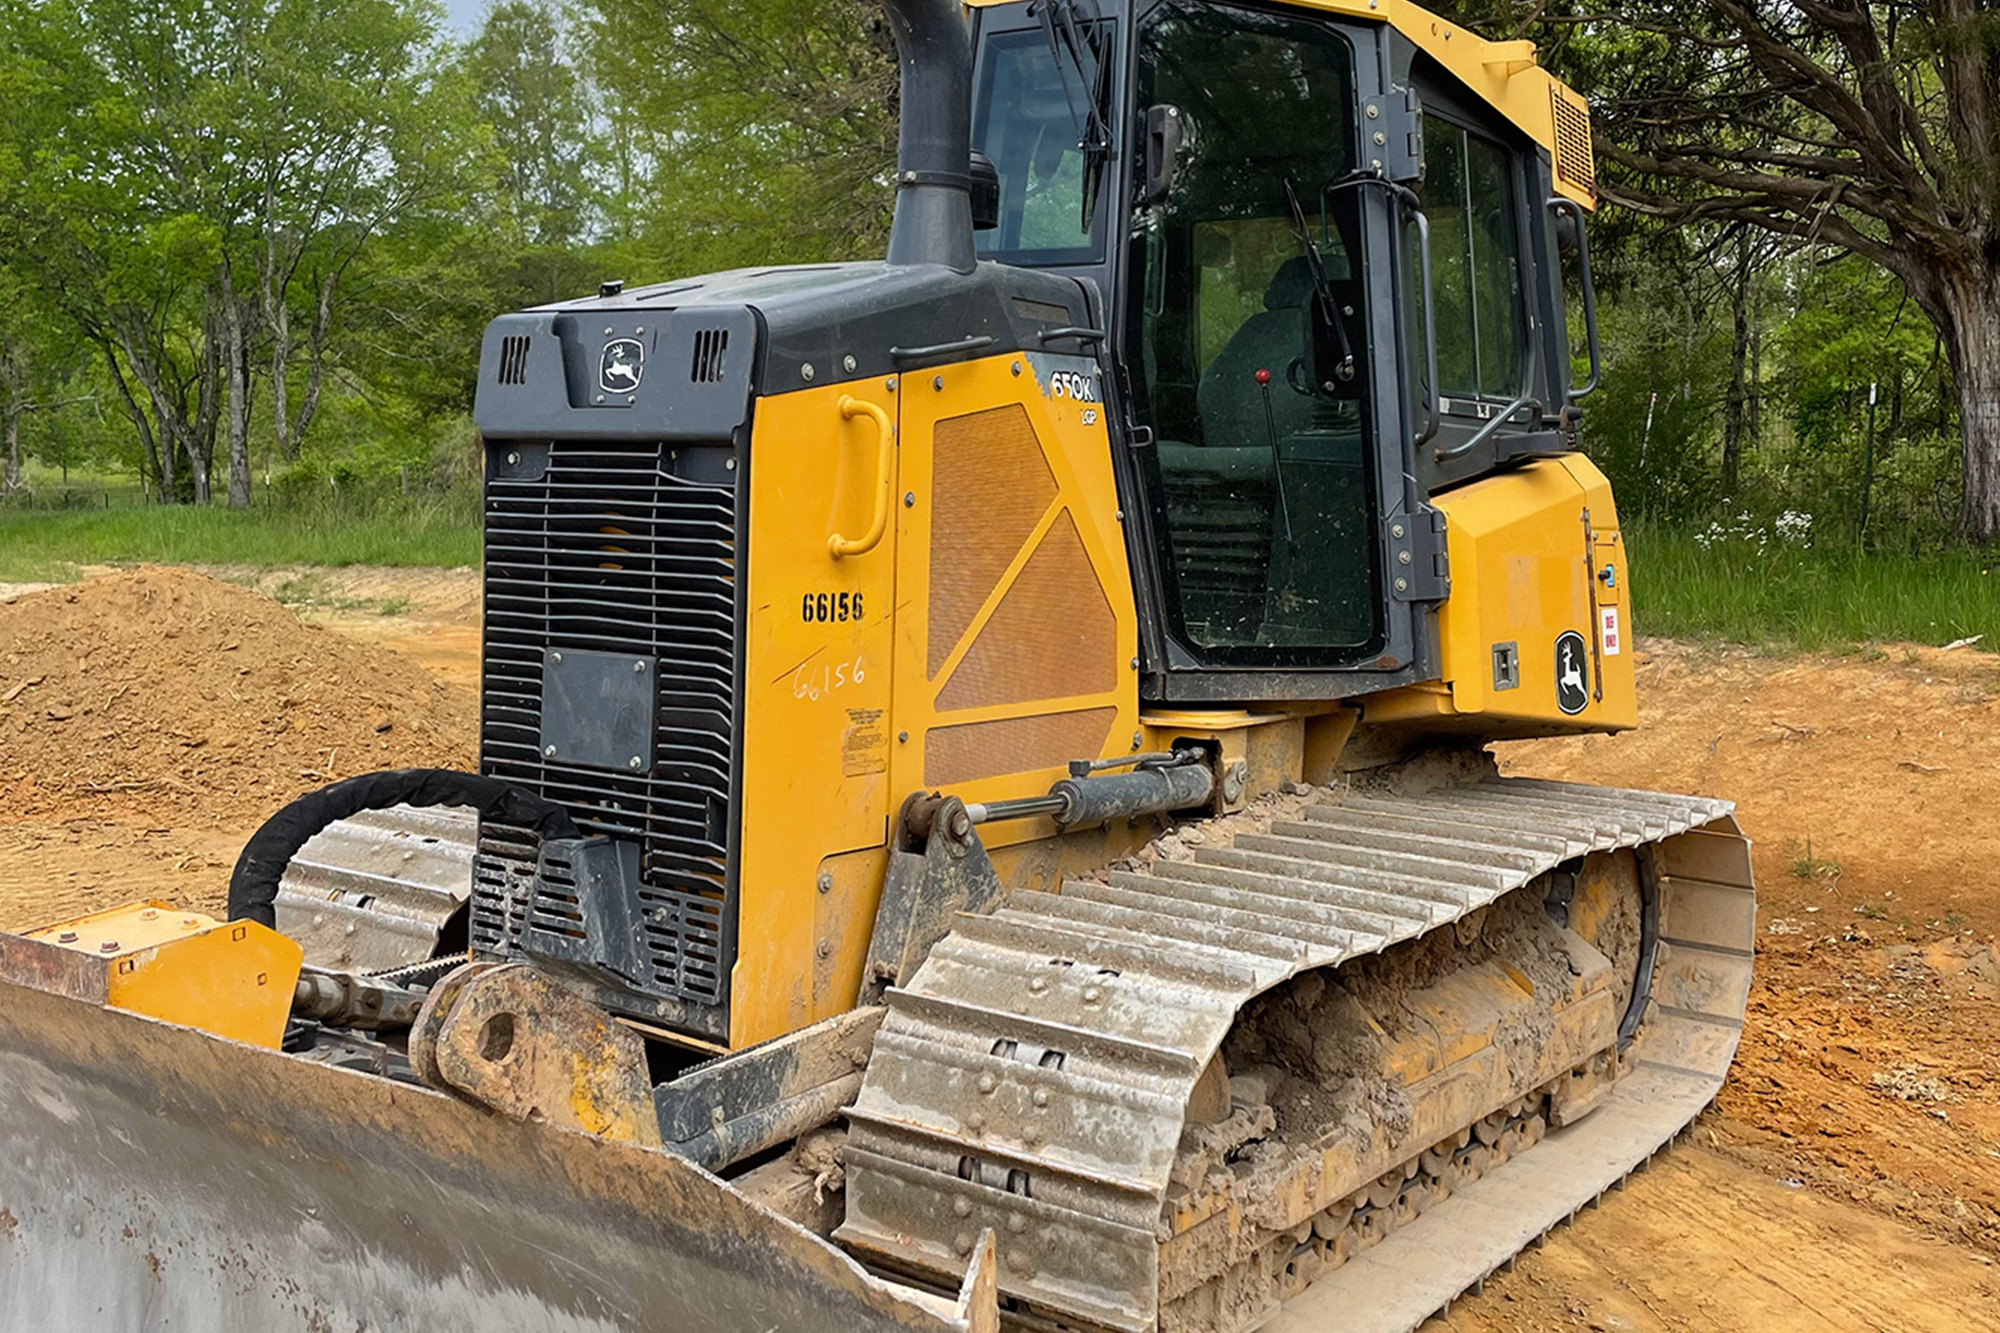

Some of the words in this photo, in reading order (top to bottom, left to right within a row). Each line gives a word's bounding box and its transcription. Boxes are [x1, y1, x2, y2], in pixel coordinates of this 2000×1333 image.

[1051, 371, 1095, 402] 650K
[802, 592, 863, 622] 66156
[792, 656, 865, 702] 66156
